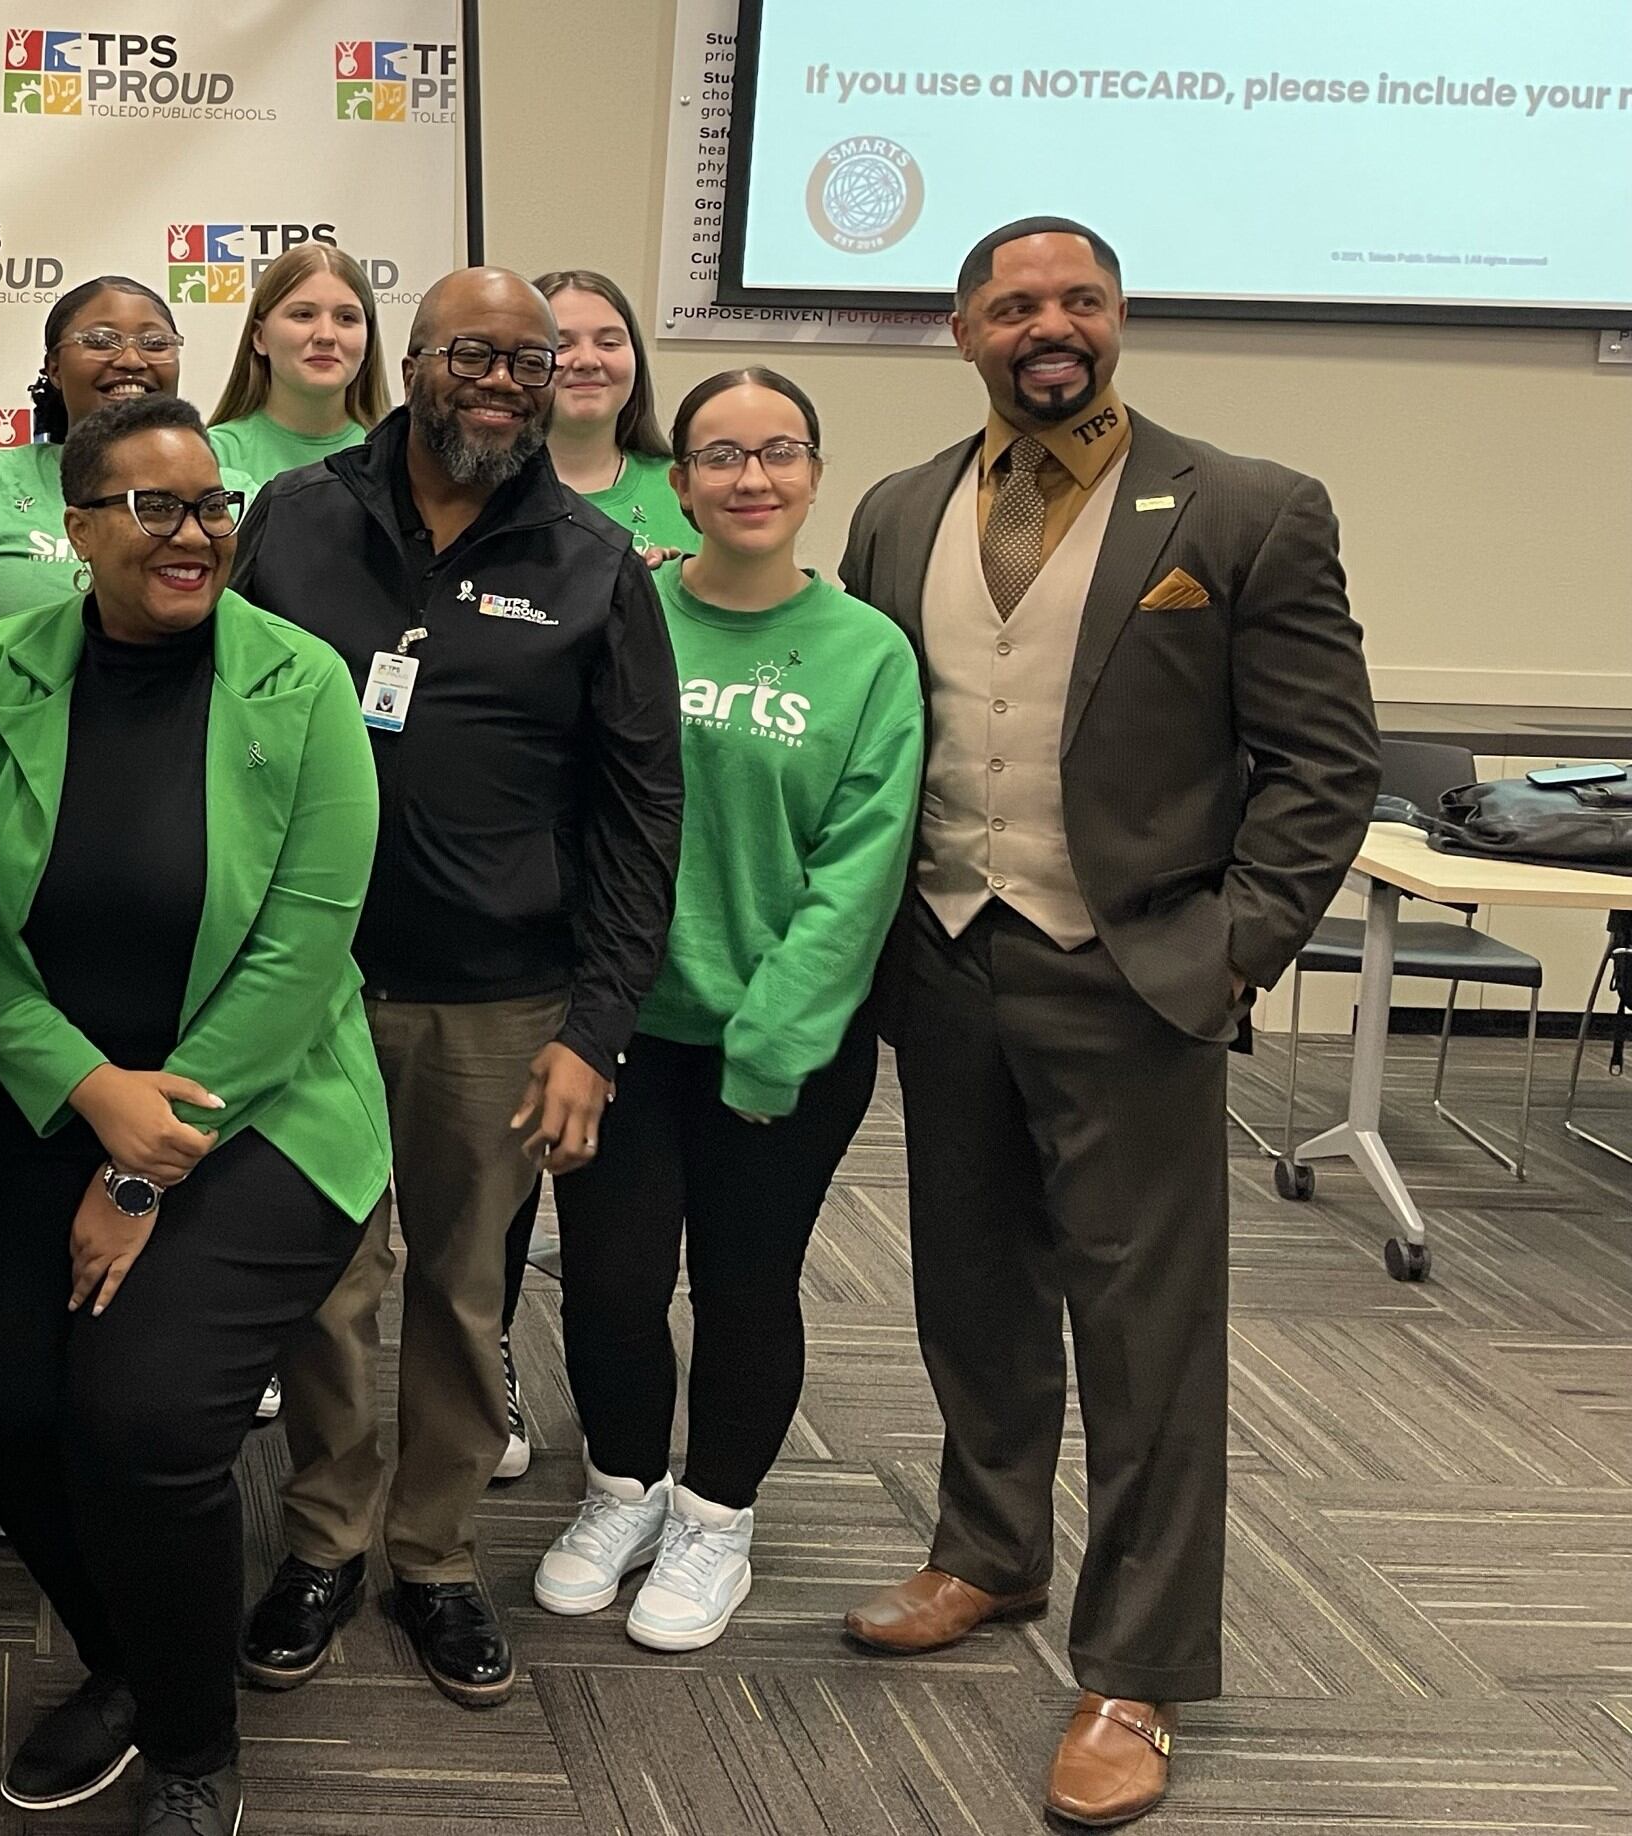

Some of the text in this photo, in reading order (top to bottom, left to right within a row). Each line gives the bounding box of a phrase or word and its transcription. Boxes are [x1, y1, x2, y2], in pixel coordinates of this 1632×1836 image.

[706, 33, 736, 45] Stu
[88, 33, 178, 68] TPS
[703, 72, 733, 84] Stu
[88, 69, 234, 105] PROUD
[806, 64, 829, 94] If
[835, 72, 910, 103] you
[916, 73, 980, 97] use
[989, 74, 1013, 97] a
[1021, 69, 1235, 104] NOTECARD,
[1244, 73, 1369, 109] please
[1377, 73, 1517, 107] include
[1525, 85, 1611, 117] your
[89, 104, 277, 122] TOLEDO PUBLIC SCHOOLS
[828, 139, 911, 168] SMARTS
[697, 160, 725, 174] phy
[695, 198, 722, 210] Gro
[694, 215, 721, 226] and
[692, 231, 720, 242] and
[373, 292, 424, 305] SCHOO
[673, 307, 823, 322] PURPOSE-DRIVEN
[1072, 407, 1119, 445] TPS
[505, 598, 530, 607] TPS
[504, 606, 547, 620] PROUD
[680, 678, 811, 735] arts
[681, 716, 804, 748] power change
